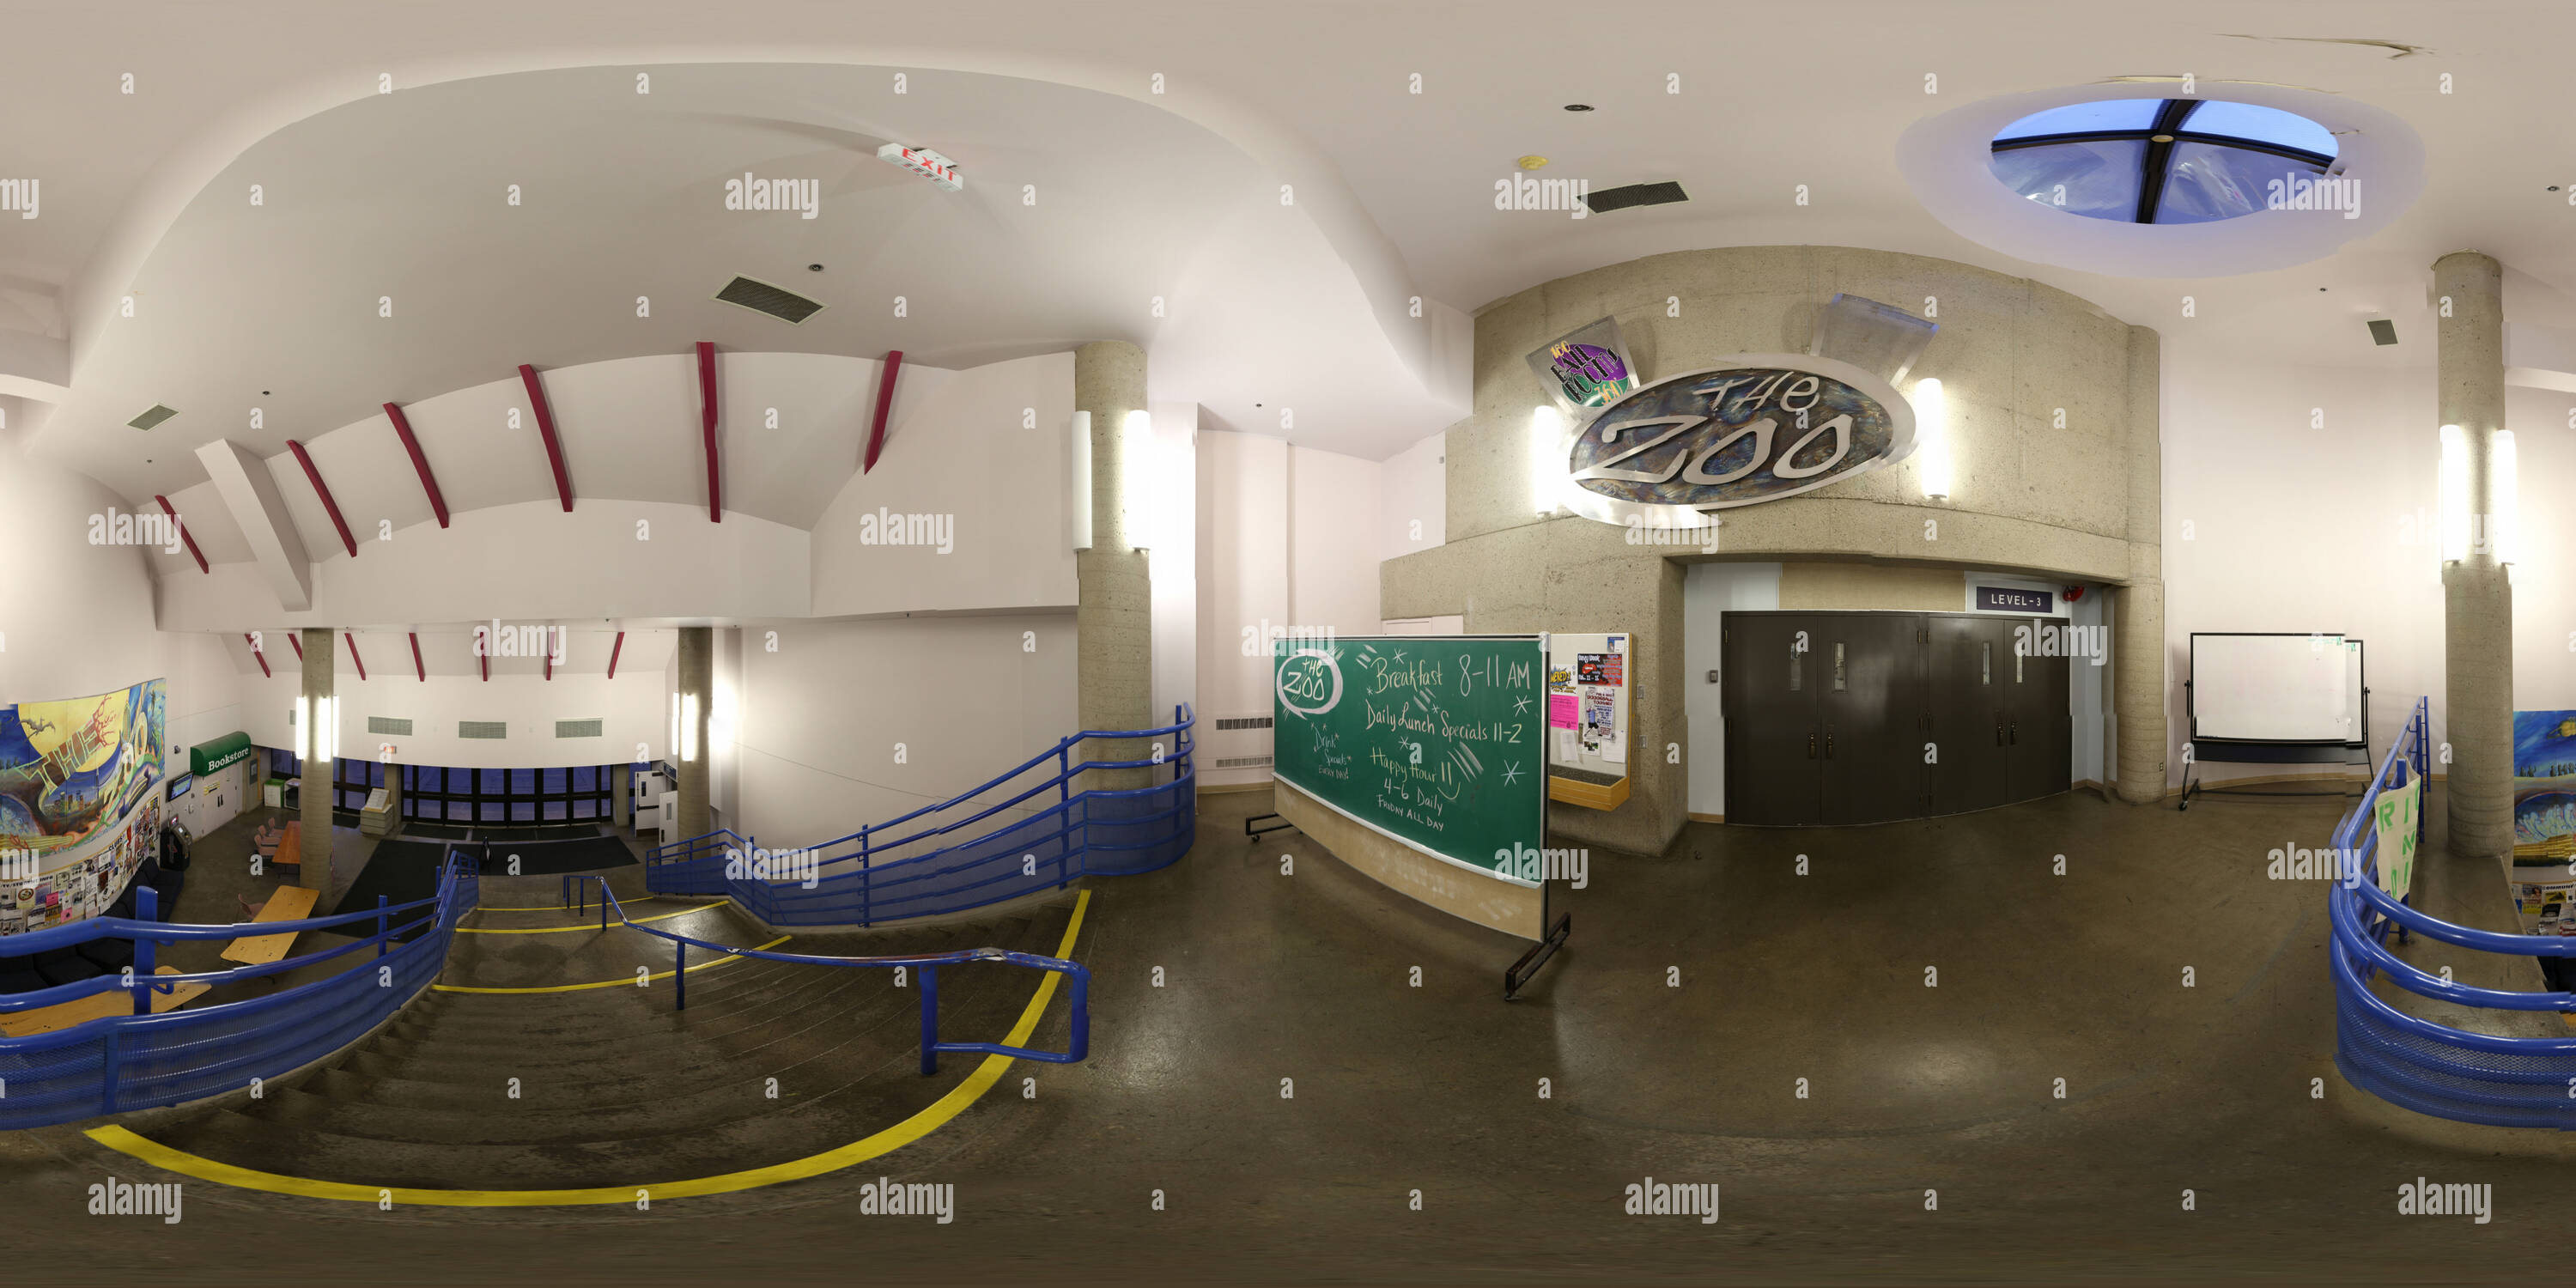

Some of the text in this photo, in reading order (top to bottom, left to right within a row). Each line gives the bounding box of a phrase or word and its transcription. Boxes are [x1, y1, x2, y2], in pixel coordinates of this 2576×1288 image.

[902, 148, 957, 181] EXIT
[1370, 653, 1531, 697] Breakfast 8-11 AM
[1365, 698, 1523, 744] Daily Lunch Specials 11-2
[208, 747, 249, 772] Bookstore
[1369, 745, 1437, 783] Happy Hour
[1383, 777, 1443, 817] 4-6 Daily
[1406, 808, 1425, 824] ALL
[1426, 816, 1444, 832] DAY
